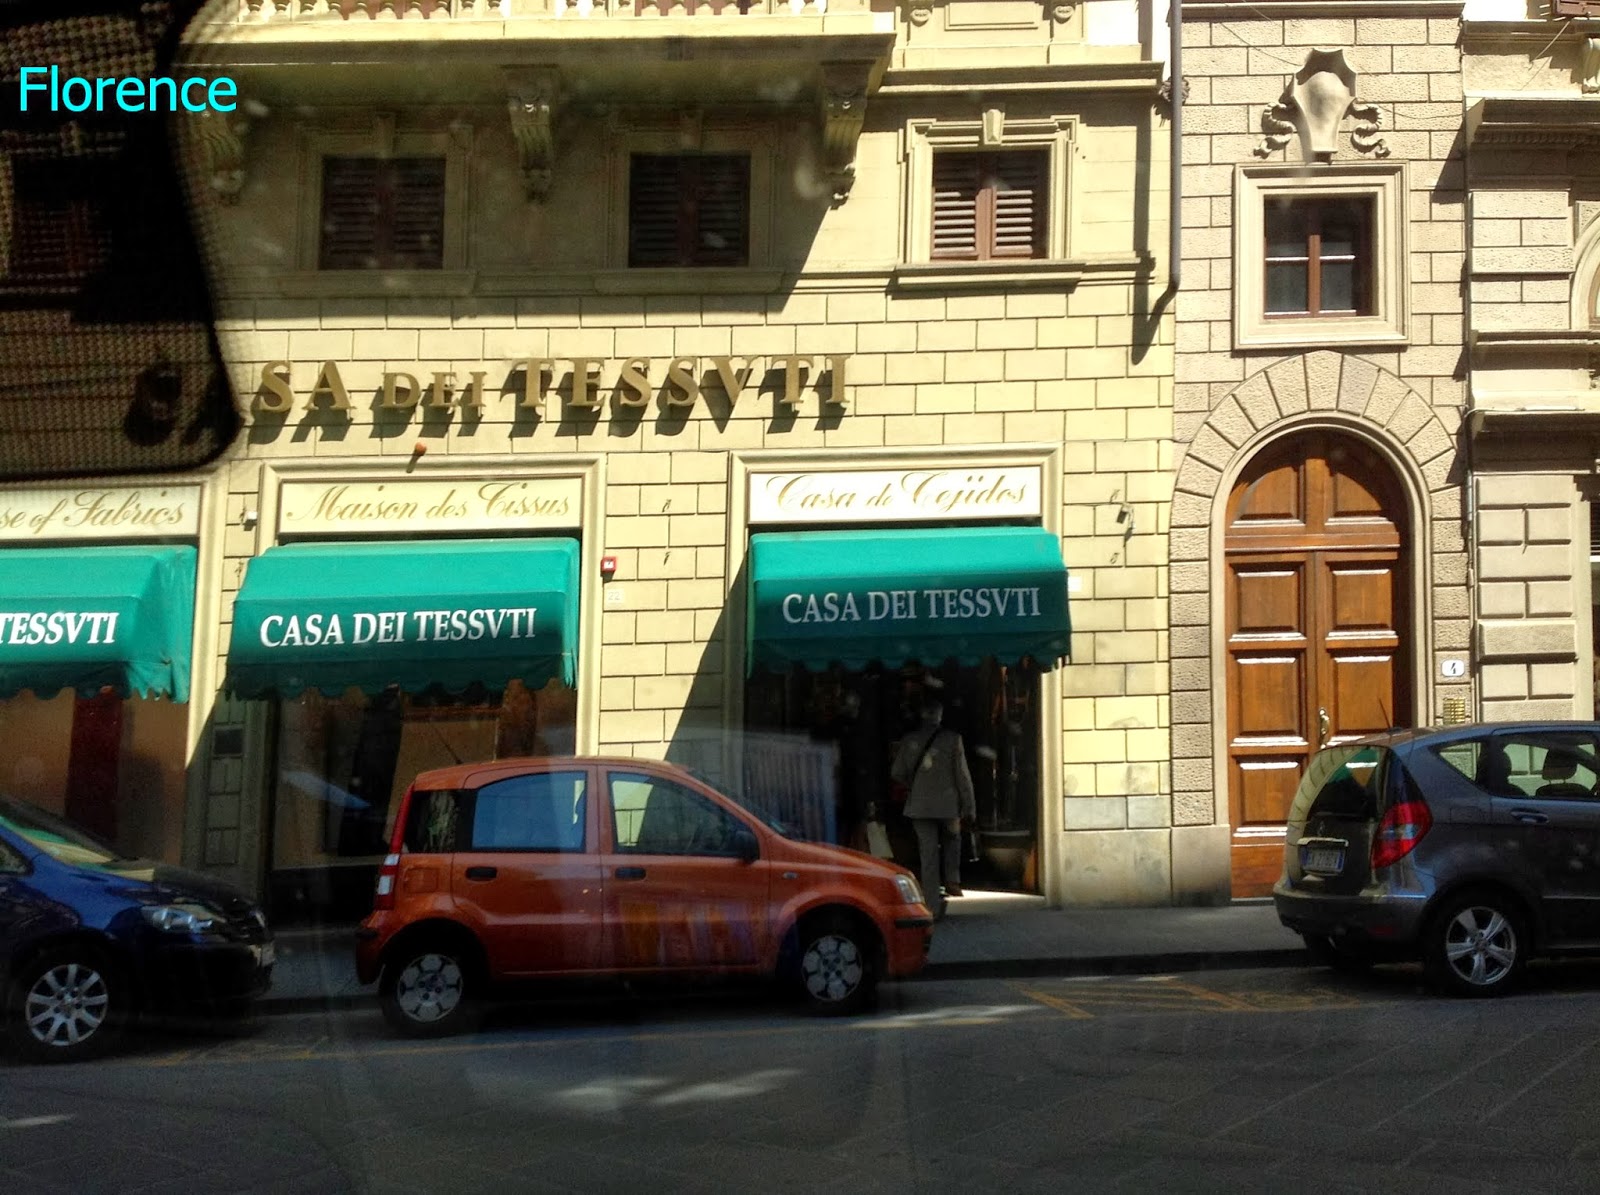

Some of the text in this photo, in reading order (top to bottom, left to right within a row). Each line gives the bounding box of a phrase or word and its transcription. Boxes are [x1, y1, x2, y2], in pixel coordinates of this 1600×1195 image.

[380, 371, 488, 408] DEI
[510, 356, 850, 408] TESSVTI
[29, 498, 69, 535] of
[63, 490, 186, 527] Fabrics
[286, 482, 570, 521] Maison des Tissus
[766, 474, 857, 512] Casa
[866, 482, 894, 508] de
[782, 587, 1042, 624] CASA DEI TESSVTI
[0, 611, 120, 645] TESSVTI
[260, 607, 537, 648] CASA DEI TESSVTI
